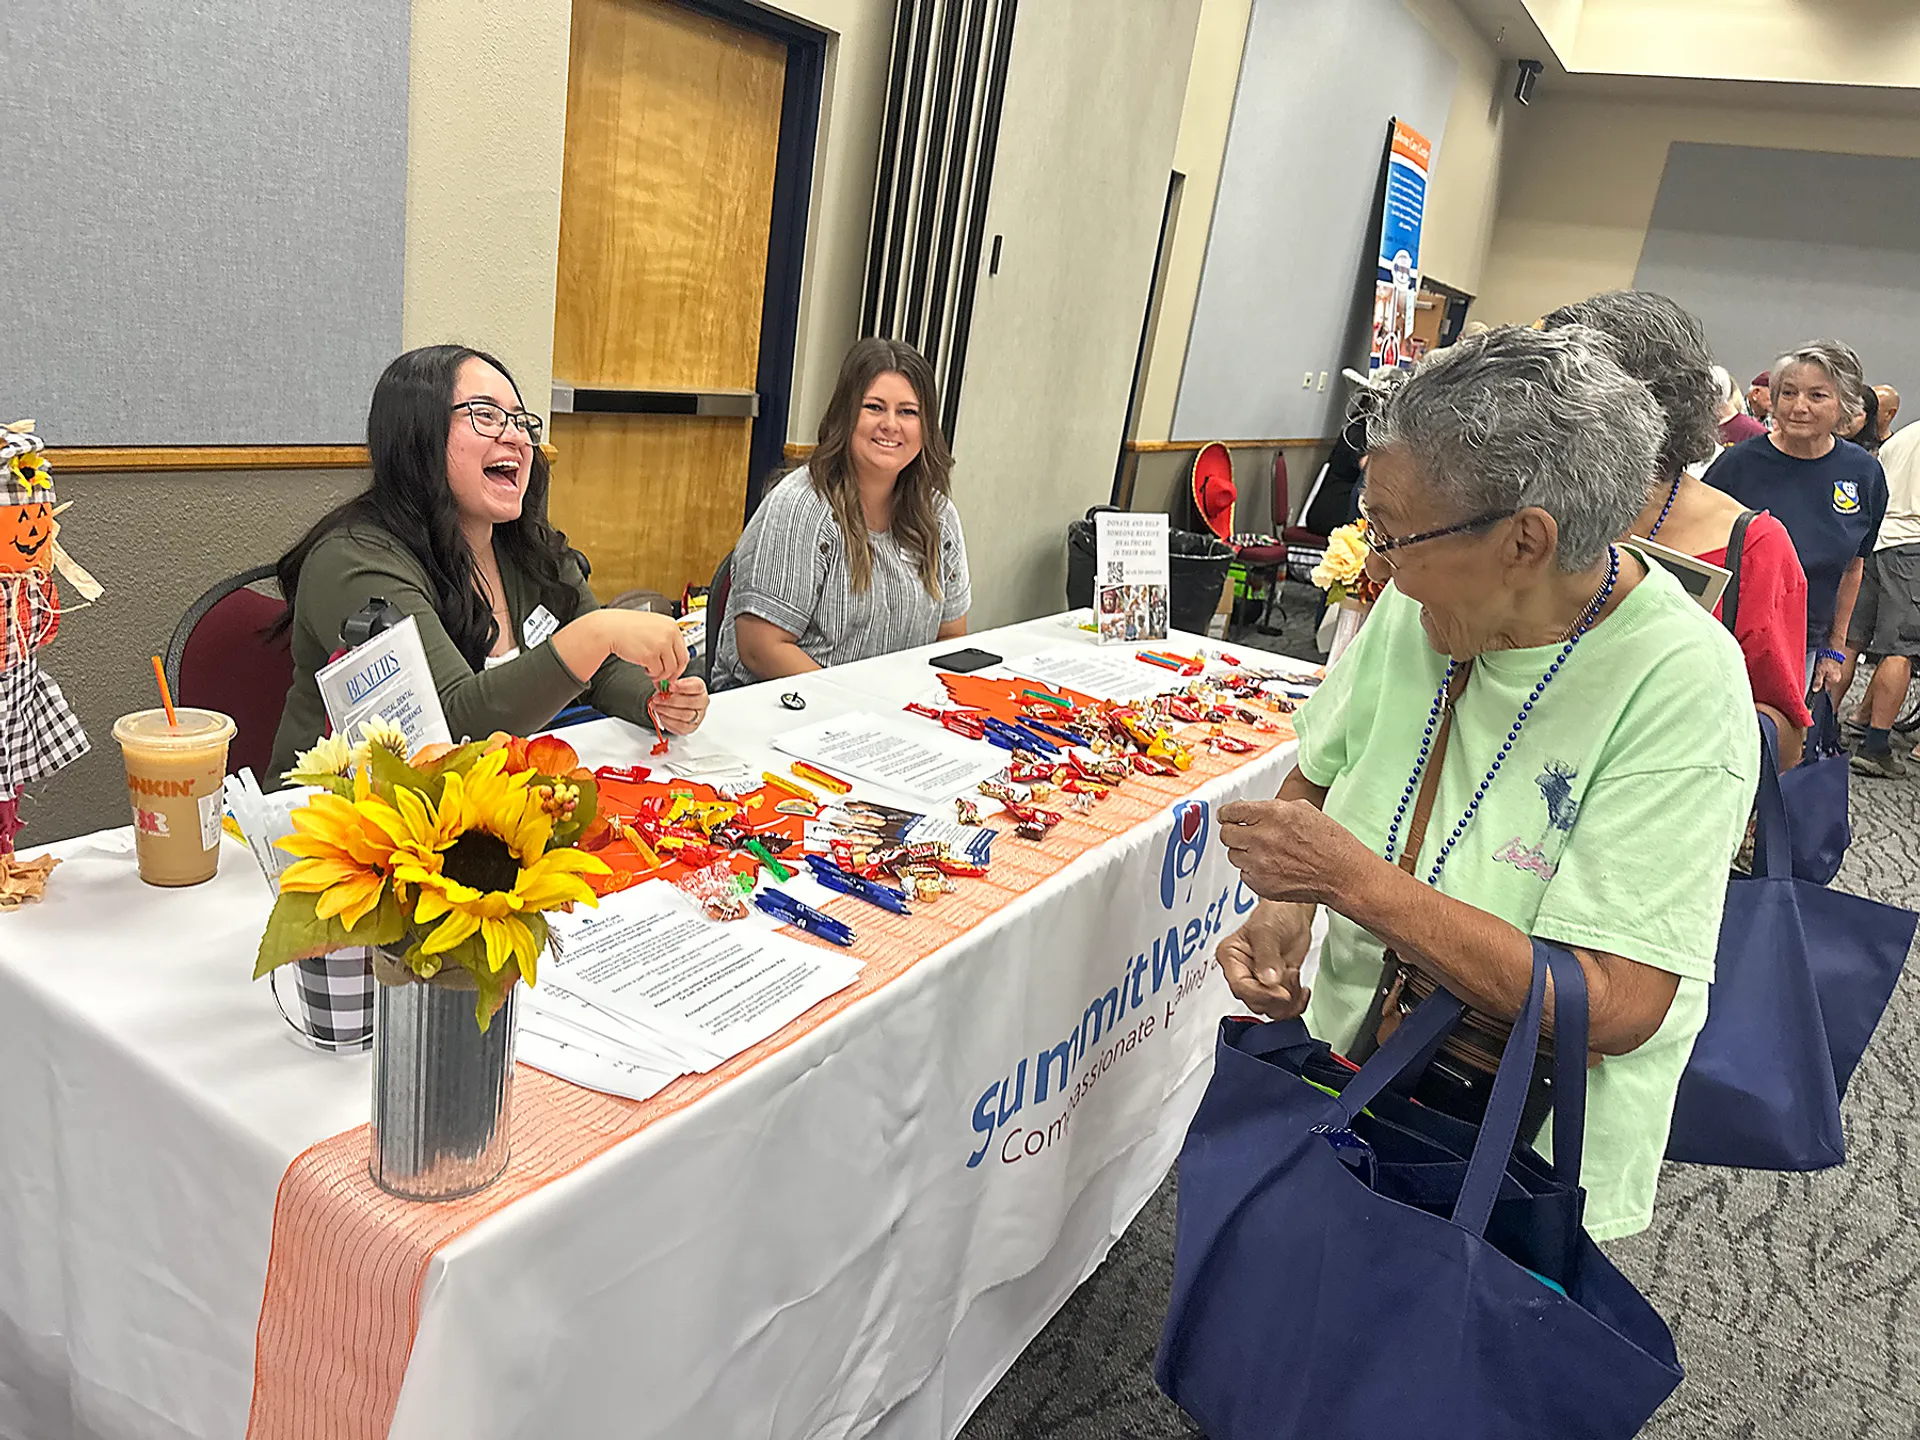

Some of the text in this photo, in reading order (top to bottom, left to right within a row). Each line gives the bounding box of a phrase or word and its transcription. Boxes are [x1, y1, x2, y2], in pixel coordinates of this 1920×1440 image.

[1106, 519, 1160, 528] DONATE AND HELP
[1106, 530, 1160, 538] SOMEONE RECEIVE
[1115, 539, 1152, 547] HEALTHCARE
[346, 650, 399, 701] BENEFITS
[400, 704, 423, 728] NSURANCE
[128, 773, 195, 798] UNKIN'
[1163, 958, 1208, 1032] Haling
